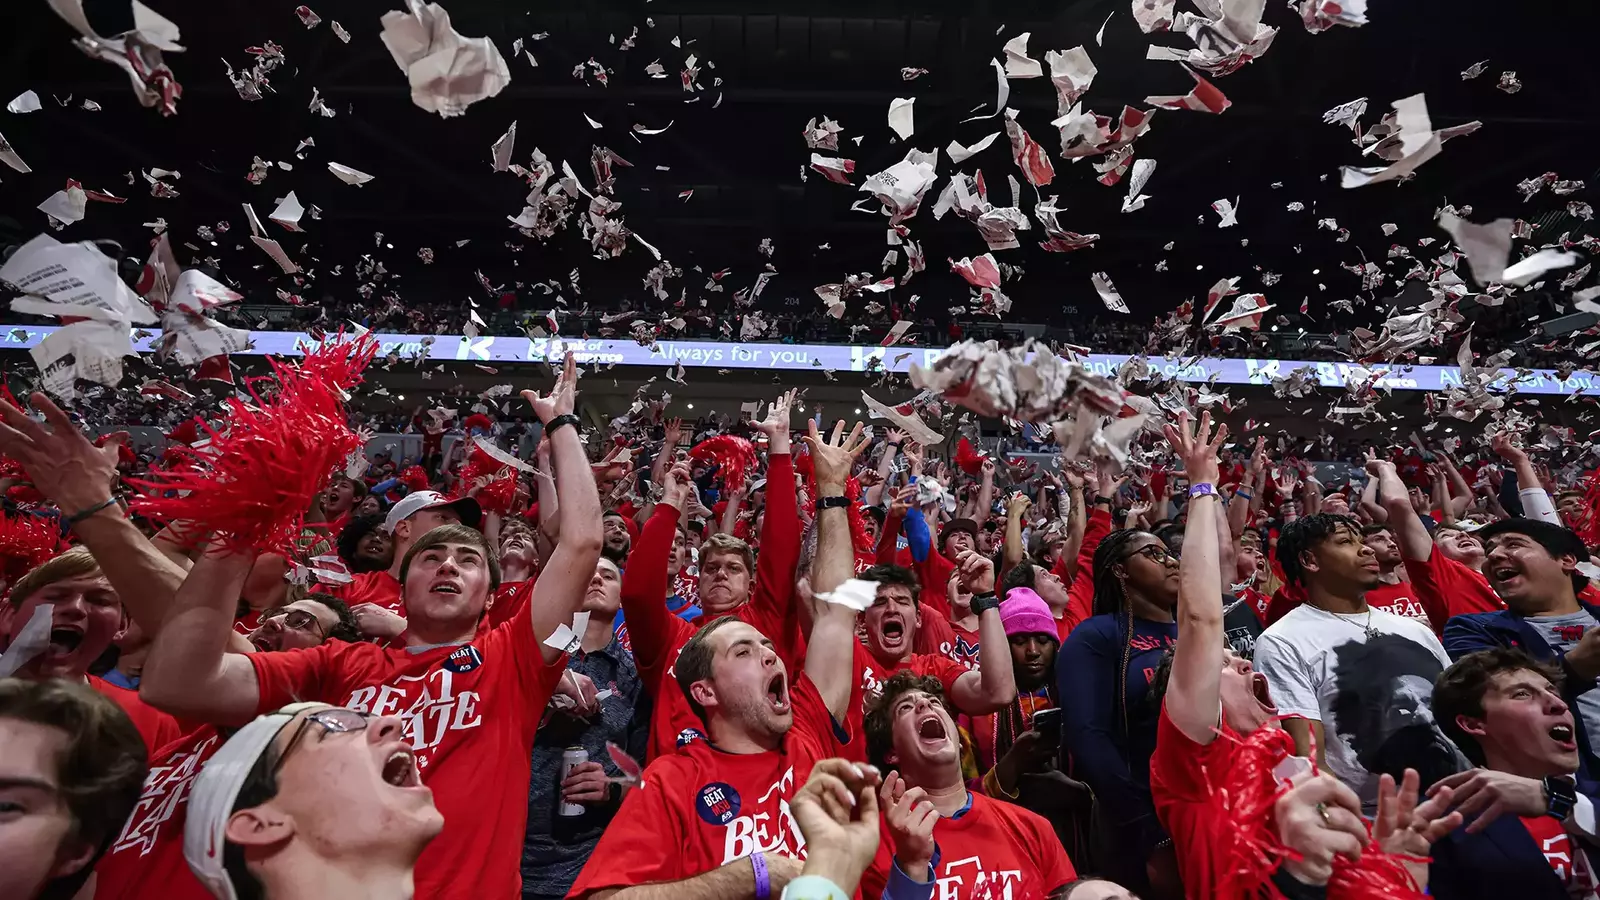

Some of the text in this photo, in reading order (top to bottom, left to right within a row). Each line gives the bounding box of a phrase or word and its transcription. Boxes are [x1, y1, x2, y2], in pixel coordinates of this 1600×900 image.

[784, 297, 800, 306] 204
[1062, 305, 1078, 314] 205
[551, 340, 586, 352] Bnk
[549, 352, 624, 362] Cmmerce
[650, 343, 813, 369] Always for you.
[449, 648, 471, 660] BEAT
[345, 668, 455, 718] BEAT
[400, 690, 483, 751] ATE
[703, 787, 726, 807] BEAT
[711, 799, 731, 817] MSU
[929, 869, 1022, 900] EAT
